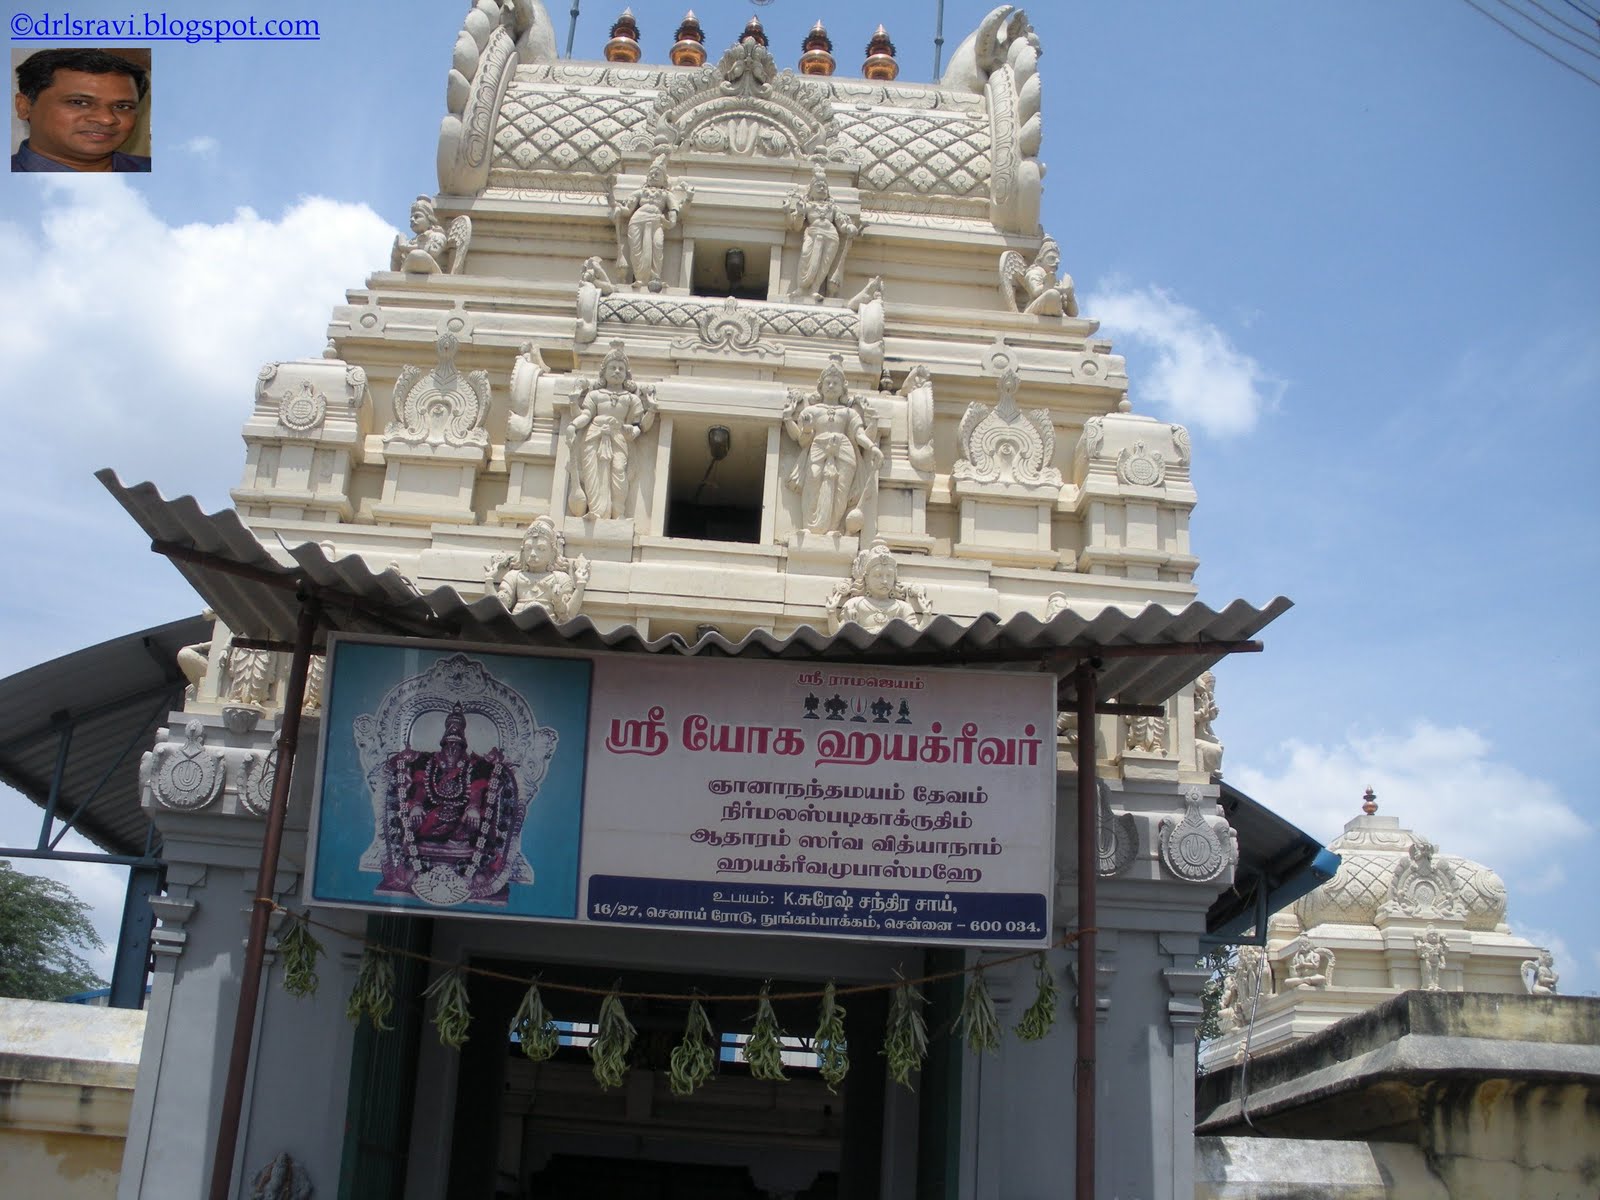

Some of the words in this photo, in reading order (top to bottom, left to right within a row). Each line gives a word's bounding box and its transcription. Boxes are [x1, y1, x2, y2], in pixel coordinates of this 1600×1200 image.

[829, 675, 925, 690] ராமஜெயம்
[606, 705, 669, 756] ஸ்ரீ
[682, 714, 805, 756] யோக
[815, 721, 1042, 768] ஹயக்ரீவர்
[708, 778, 905, 800] ஞானாநந்தமயம்
[913, 786, 988, 806] தேவம்
[690, 828, 791, 848] ஆதாரம்
[798, 830, 864, 851] ஸர்வ
[872, 834, 1003, 858] வித்யாநாம்
[593, 902, 642, 918] 16/27,
[711, 910, 757, 924] ரோடு,
[761, 911, 881, 930] நுங்கம்பாக்கம்,
[885, 917, 952, 932] சென்னை
[970, 920, 1002, 932] 600
[1005, 921, 1041, 932] 034.
[712, 891, 775, 905] உபயம்:
[858, 891, 910, 913] சந்திர
[915, 894, 958, 914] சாய்,
